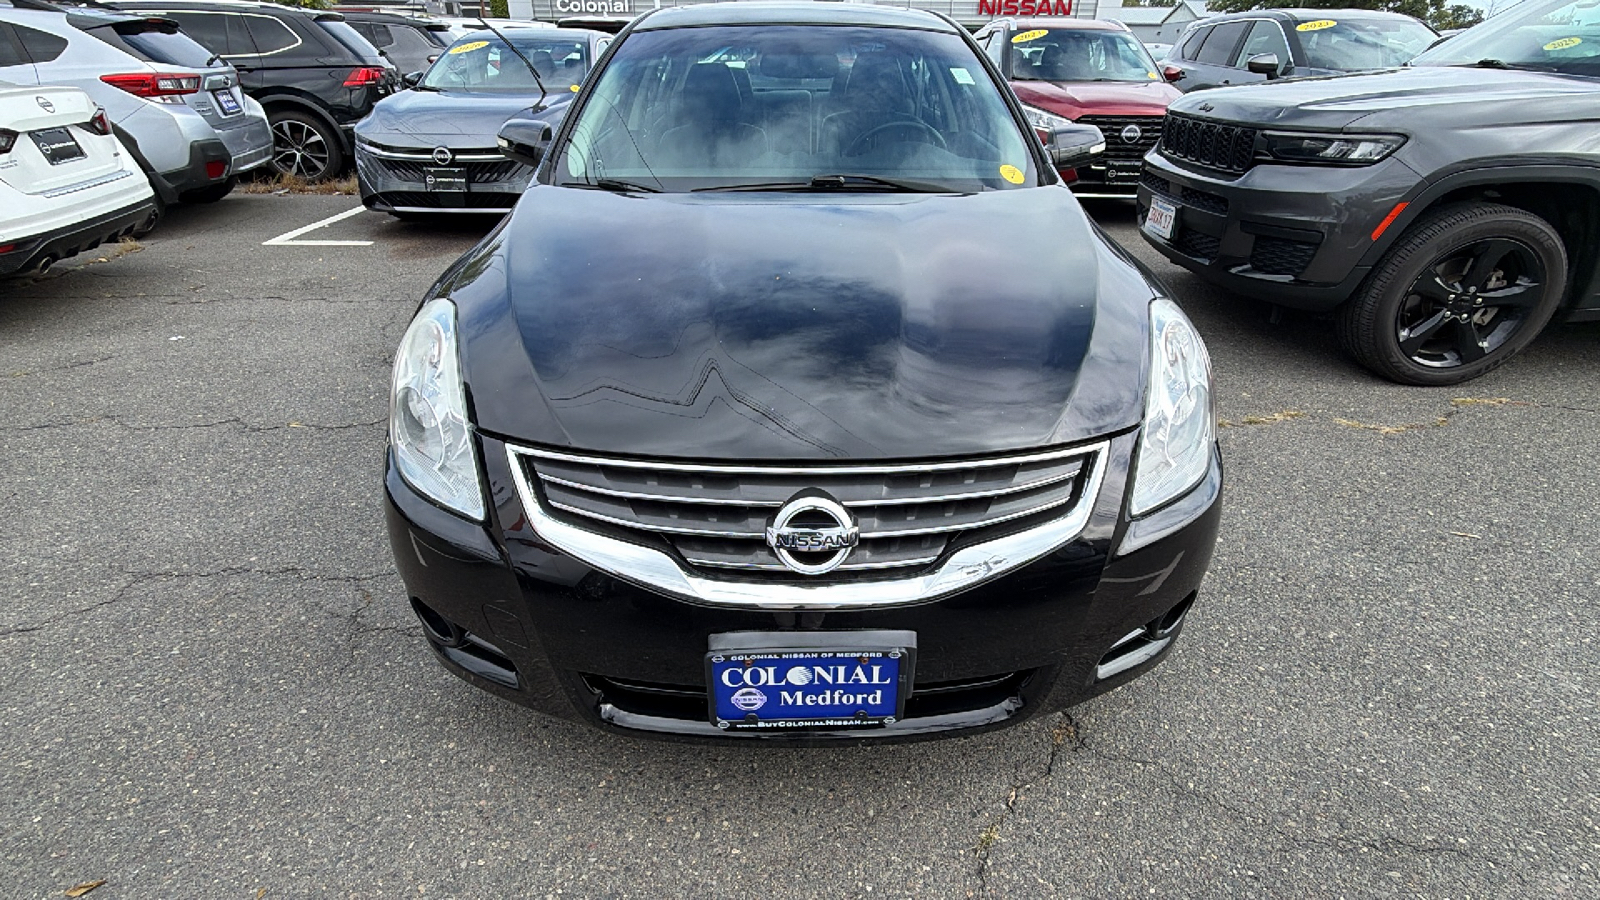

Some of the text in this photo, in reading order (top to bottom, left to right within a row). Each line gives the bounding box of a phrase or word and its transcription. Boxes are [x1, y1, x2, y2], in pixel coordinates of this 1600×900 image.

[557, 0, 629, 12] Colonial
[978, 0, 1072, 15] NISSAN
[776, 532, 849, 548] NISSAN
[722, 666, 890, 687] COLONIAL
[780, 690, 882, 706] Medford
